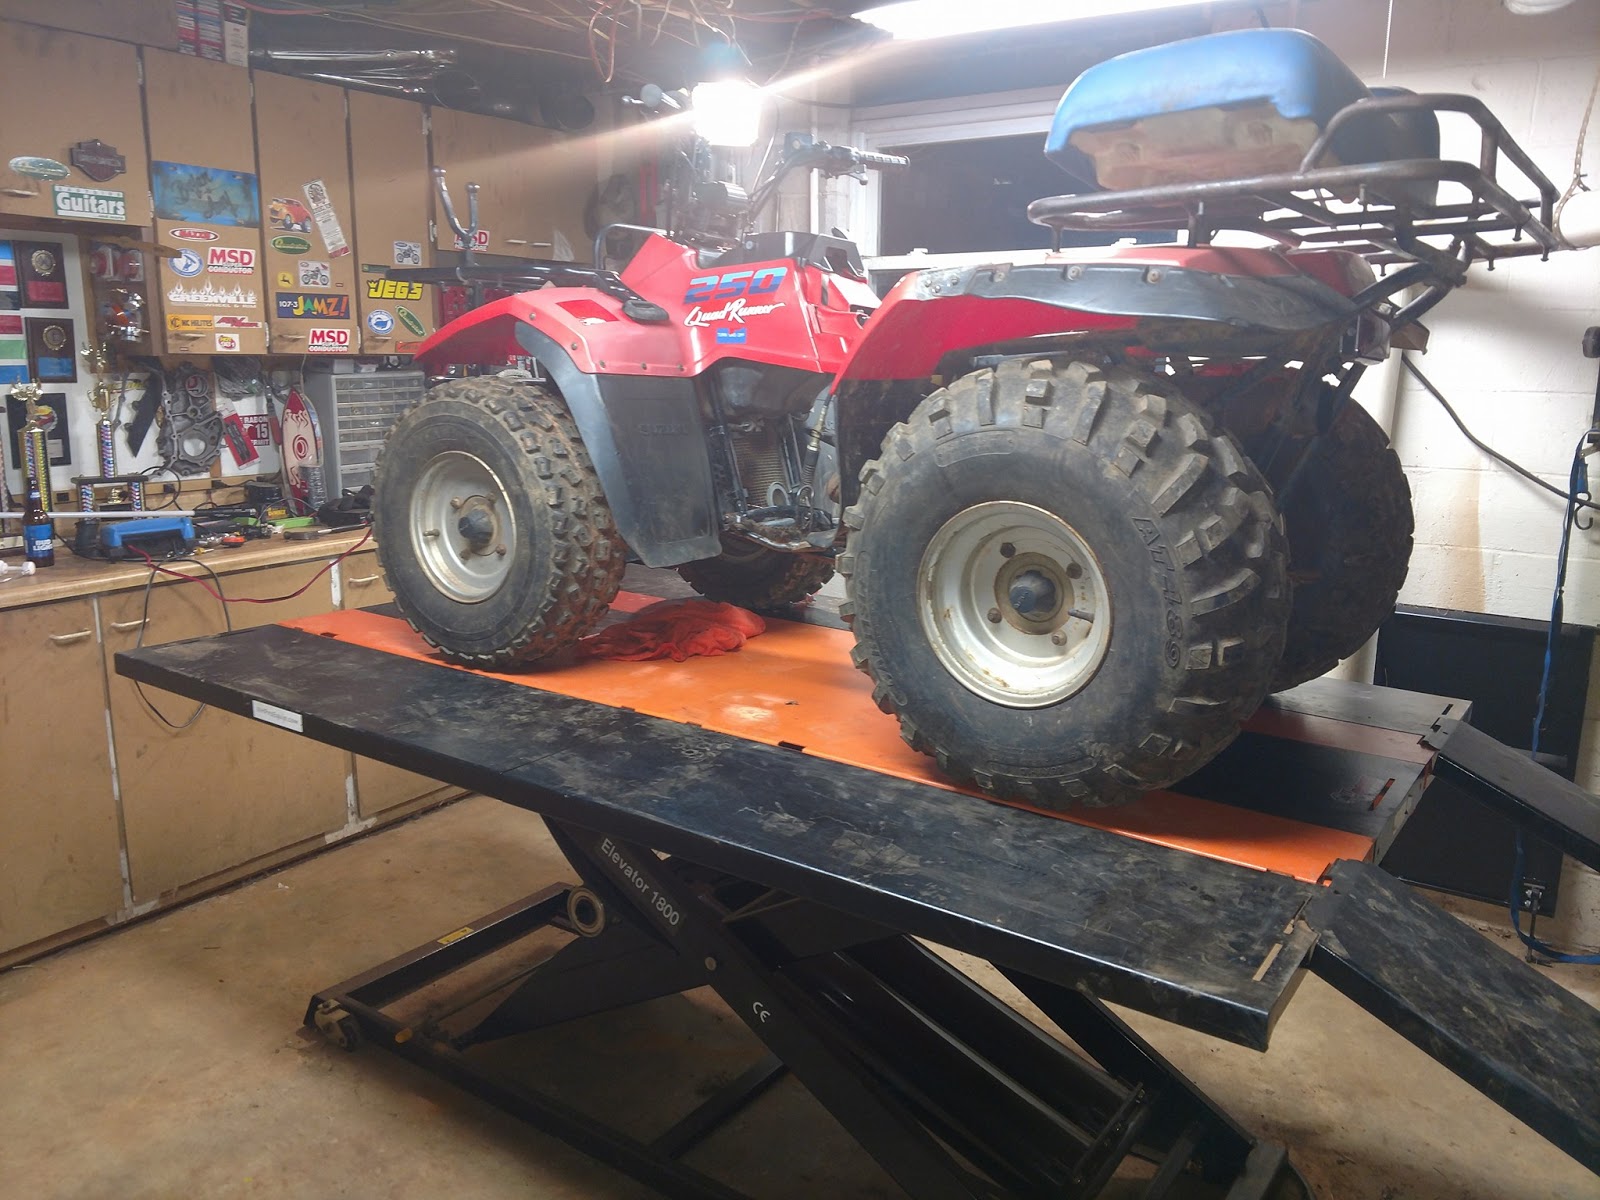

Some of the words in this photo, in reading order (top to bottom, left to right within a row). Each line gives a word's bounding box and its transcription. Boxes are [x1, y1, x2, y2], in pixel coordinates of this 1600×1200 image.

[56, 191, 125, 215] Guitars
[210, 249, 253, 265] MSD
[368, 279, 424, 299] JEGS
[684, 267, 788, 304] 250
[293, 295, 349, 317] JAMZ!
[311, 330, 348, 344] MSD
[255, 423, 268, 438] 15
[601, 838, 650, 893] Elevator
[650, 891, 680, 925] 1800
